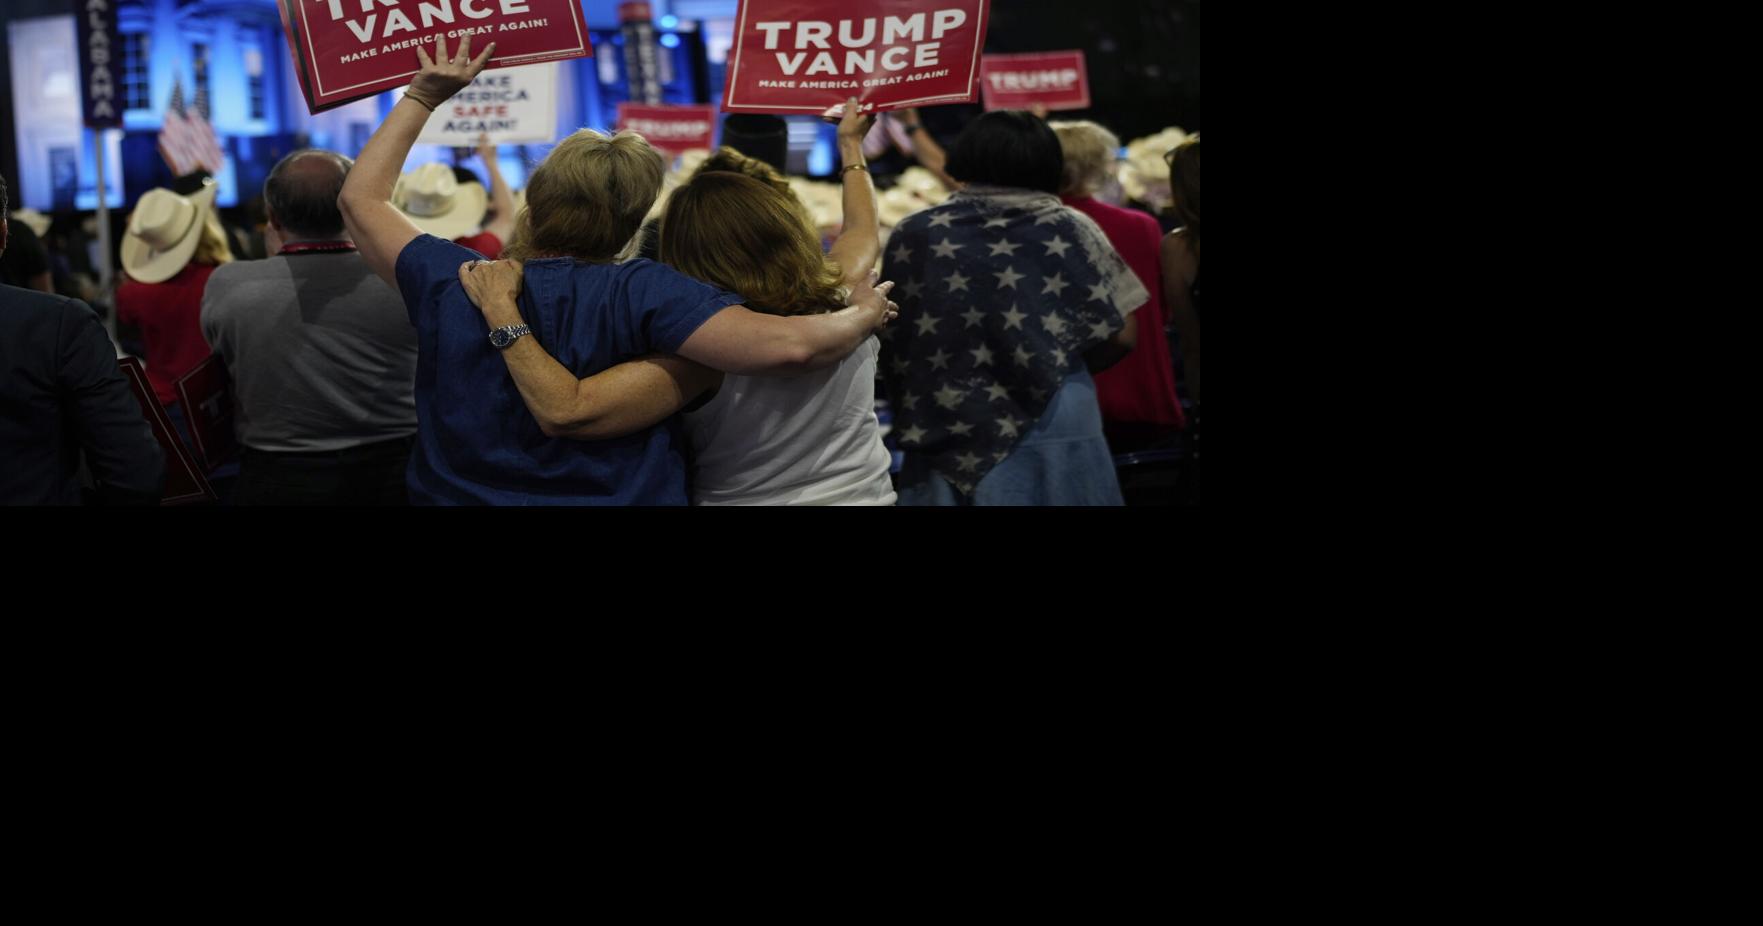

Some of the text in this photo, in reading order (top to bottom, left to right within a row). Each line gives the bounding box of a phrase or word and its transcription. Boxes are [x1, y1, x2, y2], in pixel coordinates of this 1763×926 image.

[345, 0, 530, 44] VANCE
[756, 9, 967, 50] TRUMP
[340, 48, 378, 64] MAKE
[447, 25, 493, 39] GREAT
[499, 18, 548, 32] AGAIN!
[775, 42, 942, 76] VANCE
[470, 77, 511, 87] AKE
[758, 69, 949, 89] MAKE AMERICA GREAT AGAIN!
[990, 69, 1077, 91] TRUMP
[449, 90, 529, 101] MERICA
[452, 105, 508, 118] SAFE
